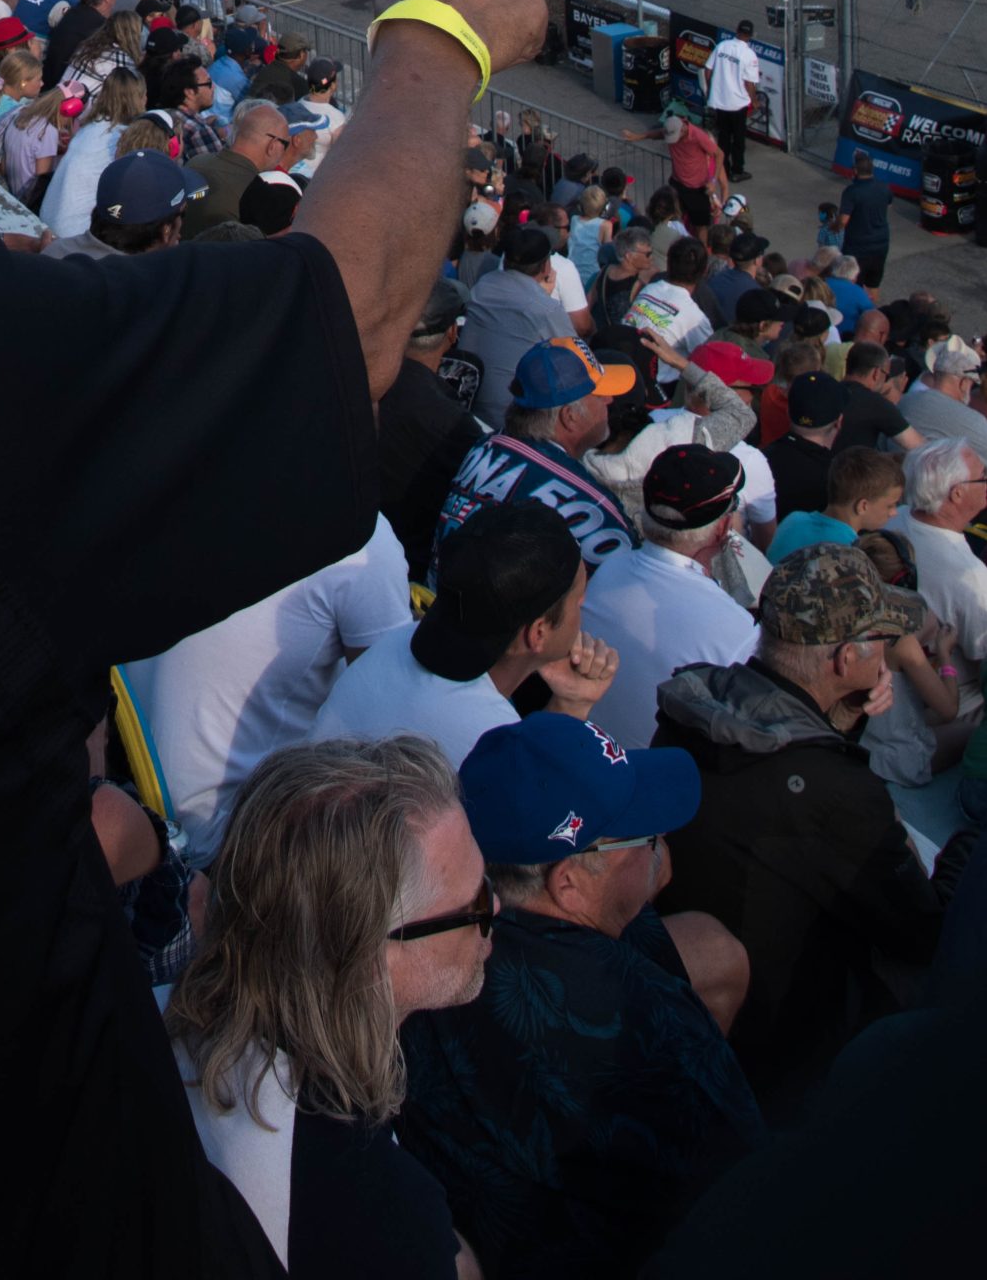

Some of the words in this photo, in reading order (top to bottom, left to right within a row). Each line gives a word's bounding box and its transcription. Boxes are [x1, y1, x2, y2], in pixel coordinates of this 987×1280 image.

[810, 61, 825, 72] ONLY
[807, 88, 836, 102] ALLOWED
[889, 162, 913, 177] PARTS
[451, 445, 528, 504] ONA
